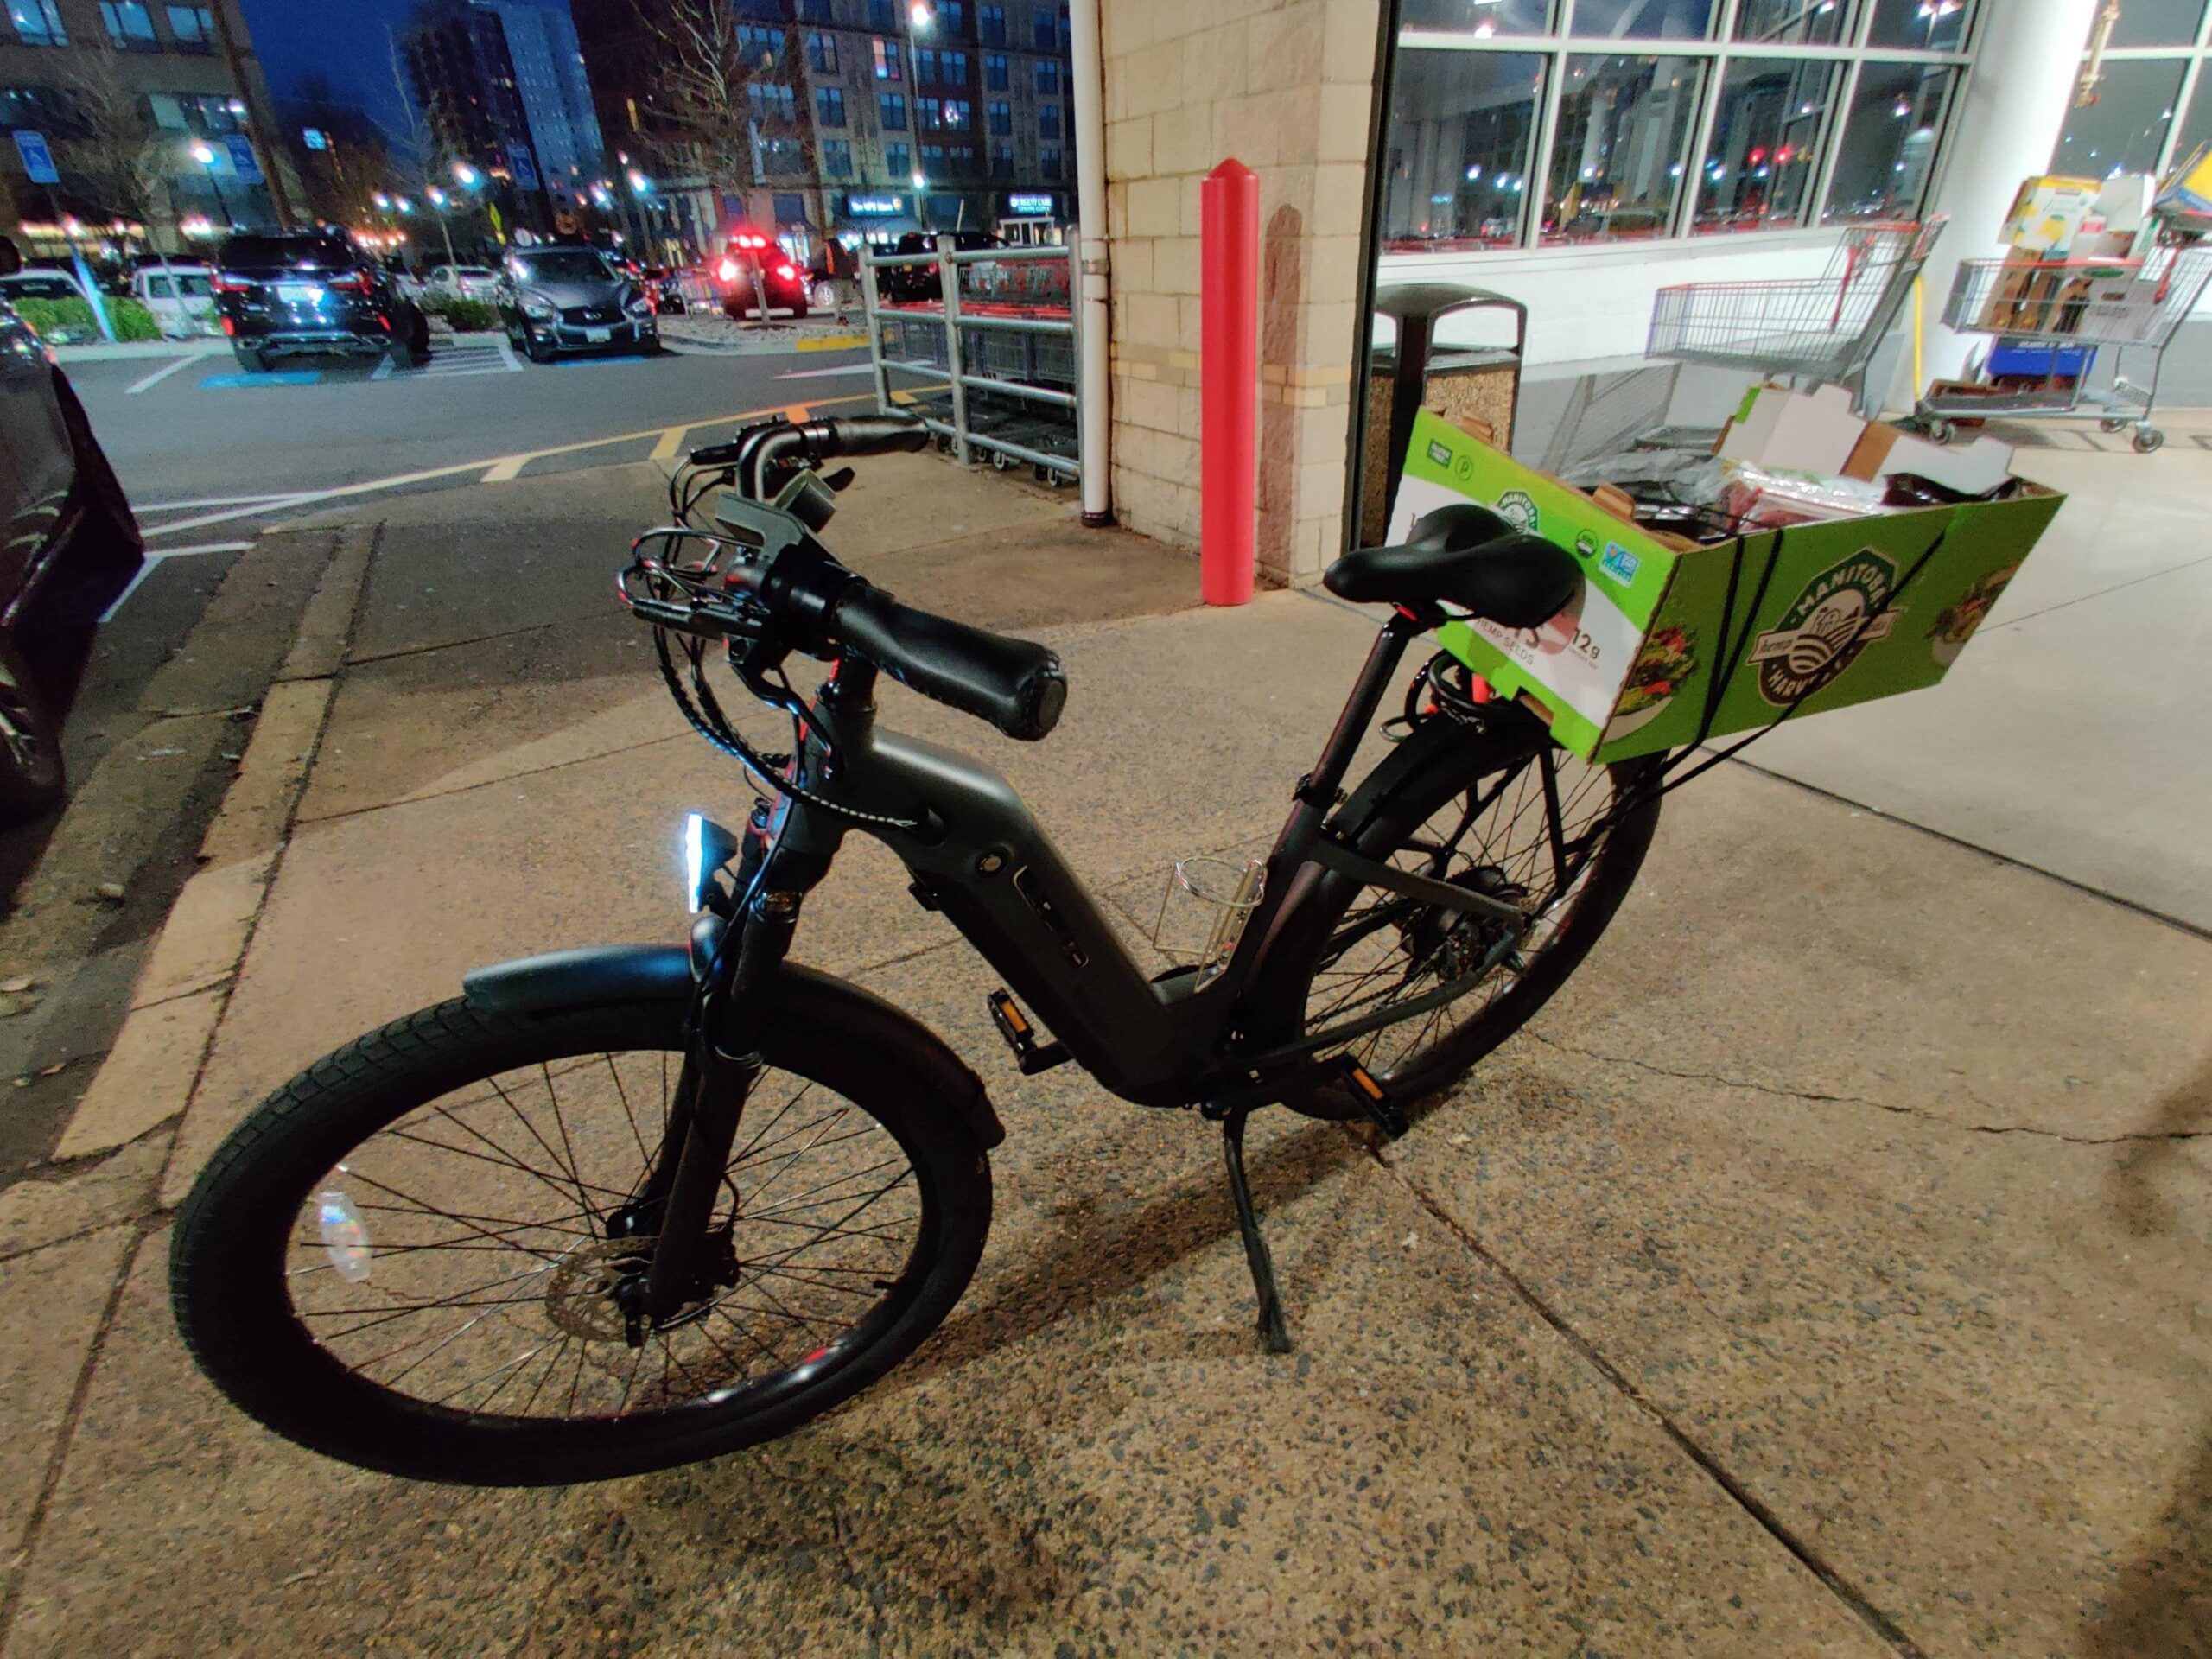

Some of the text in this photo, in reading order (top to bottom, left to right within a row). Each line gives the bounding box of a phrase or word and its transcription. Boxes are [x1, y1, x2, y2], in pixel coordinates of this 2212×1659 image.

[1500, 493, 1536, 524] MANITOBA
[1797, 563, 1887, 615] MANITOBA
[1503, 637, 1535, 666] SEEDS
[1573, 627, 1601, 659] 12g
[1758, 639, 1794, 654] hemp
